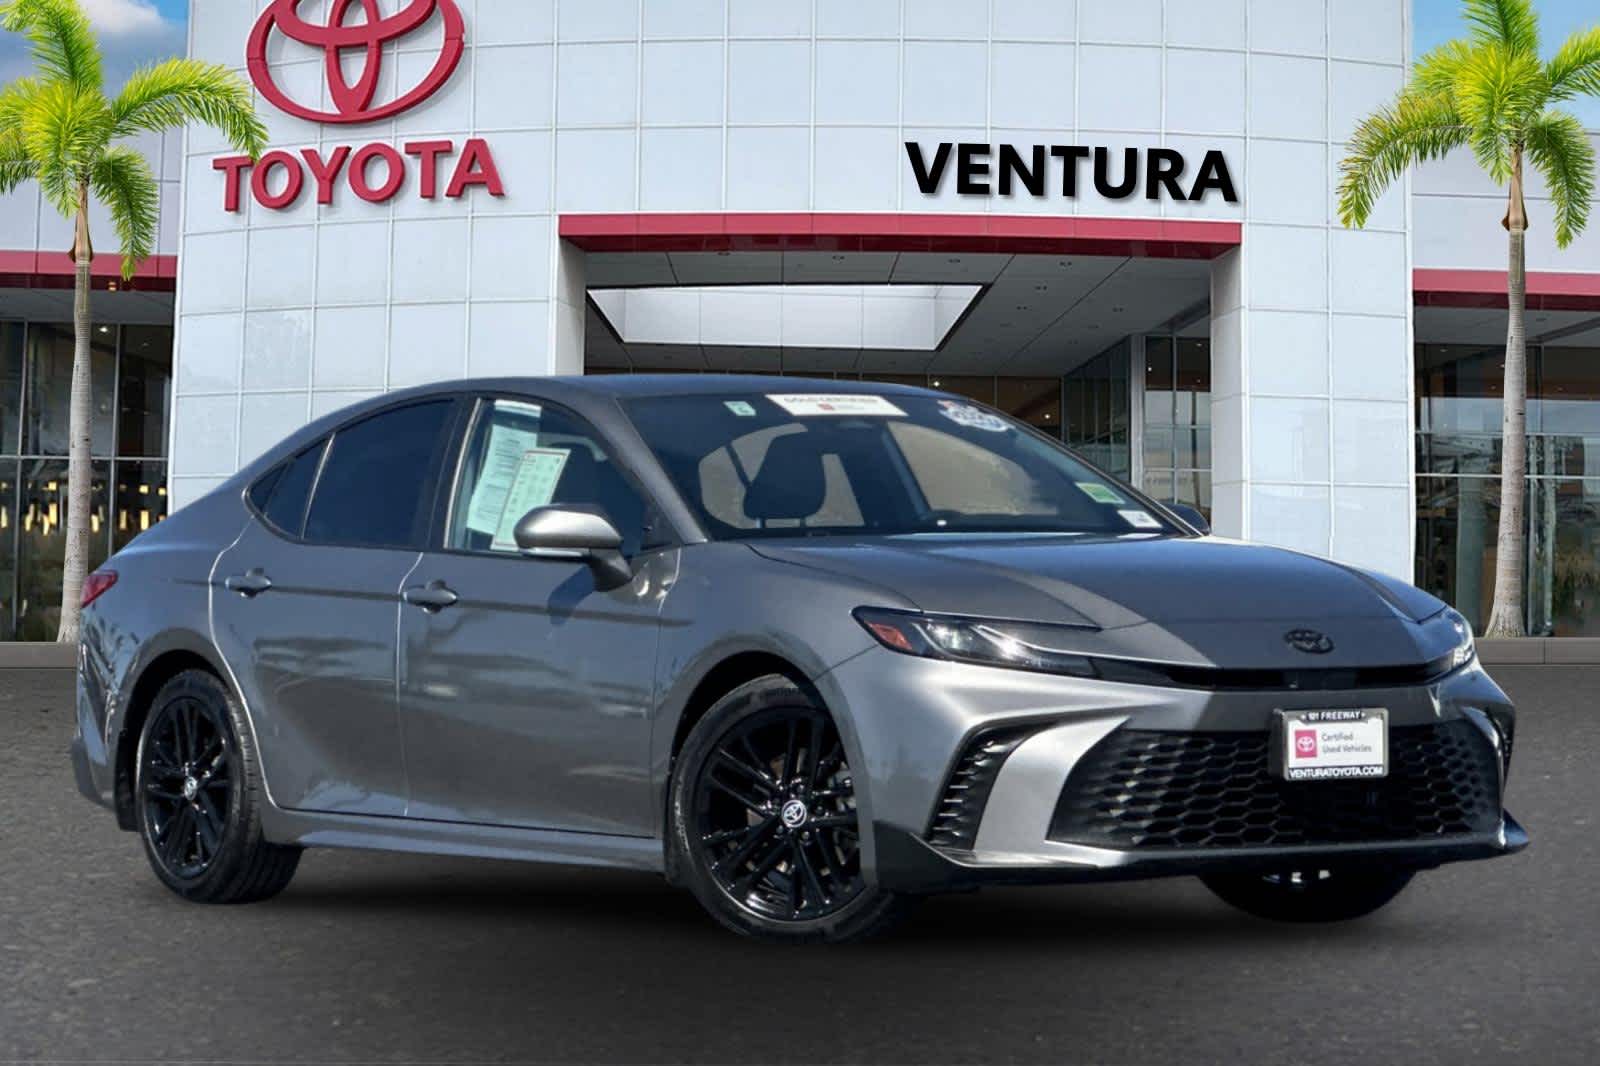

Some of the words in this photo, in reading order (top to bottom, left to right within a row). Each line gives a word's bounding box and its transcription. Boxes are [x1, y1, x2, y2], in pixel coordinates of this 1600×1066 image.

[213, 138, 505, 212] TOYOTA
[904, 142, 1238, 202] VENTURA
[1321, 710, 1360, 720] FREEWAY
[1322, 732, 1354, 741] Certified
[1289, 767, 1383, 778] VENTURATOYOTA.COM
